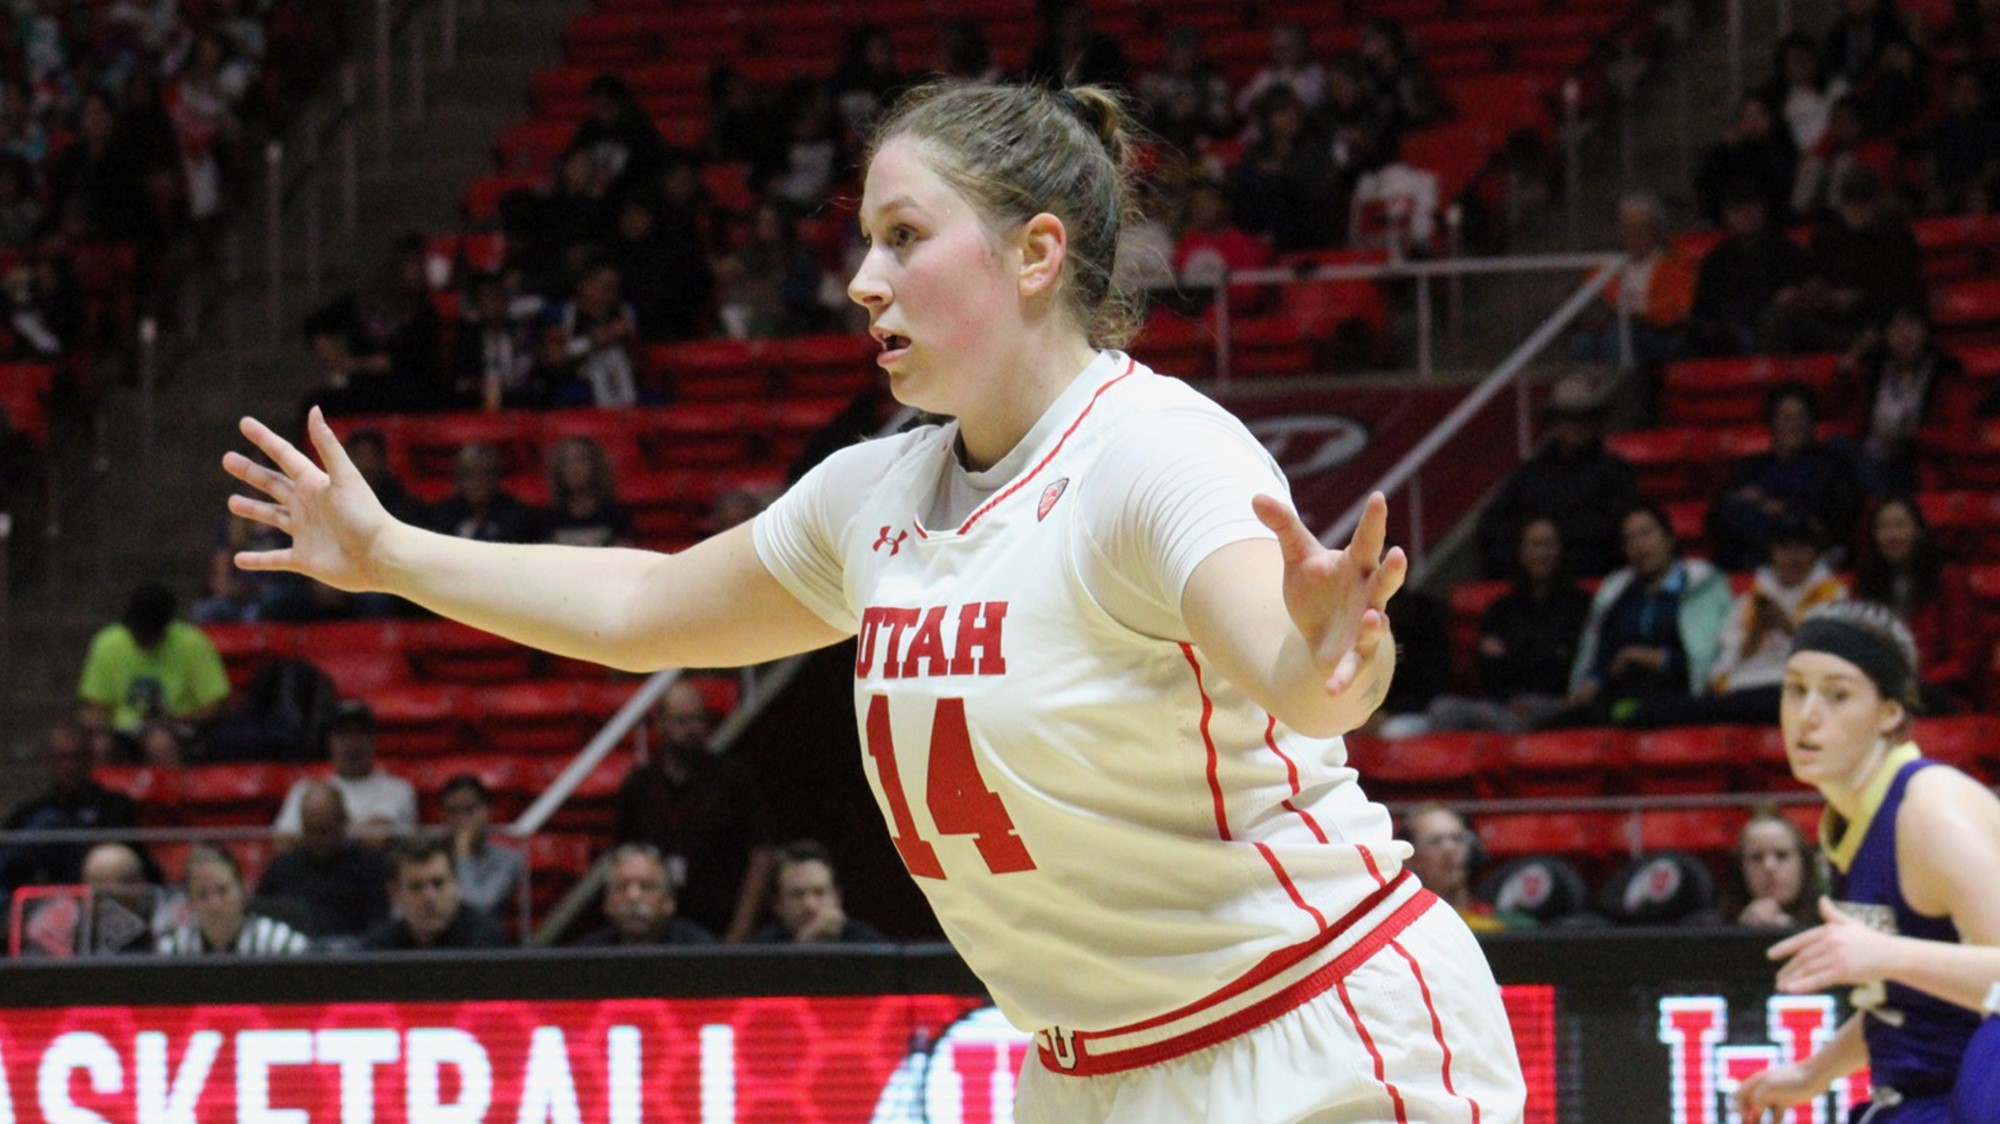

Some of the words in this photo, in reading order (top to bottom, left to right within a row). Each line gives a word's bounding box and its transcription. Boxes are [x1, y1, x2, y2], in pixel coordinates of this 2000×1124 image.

[856, 601, 1009, 679] UTAH
[866, 694, 1037, 881] 14
[0, 1024, 737, 1124] SKETBALL
